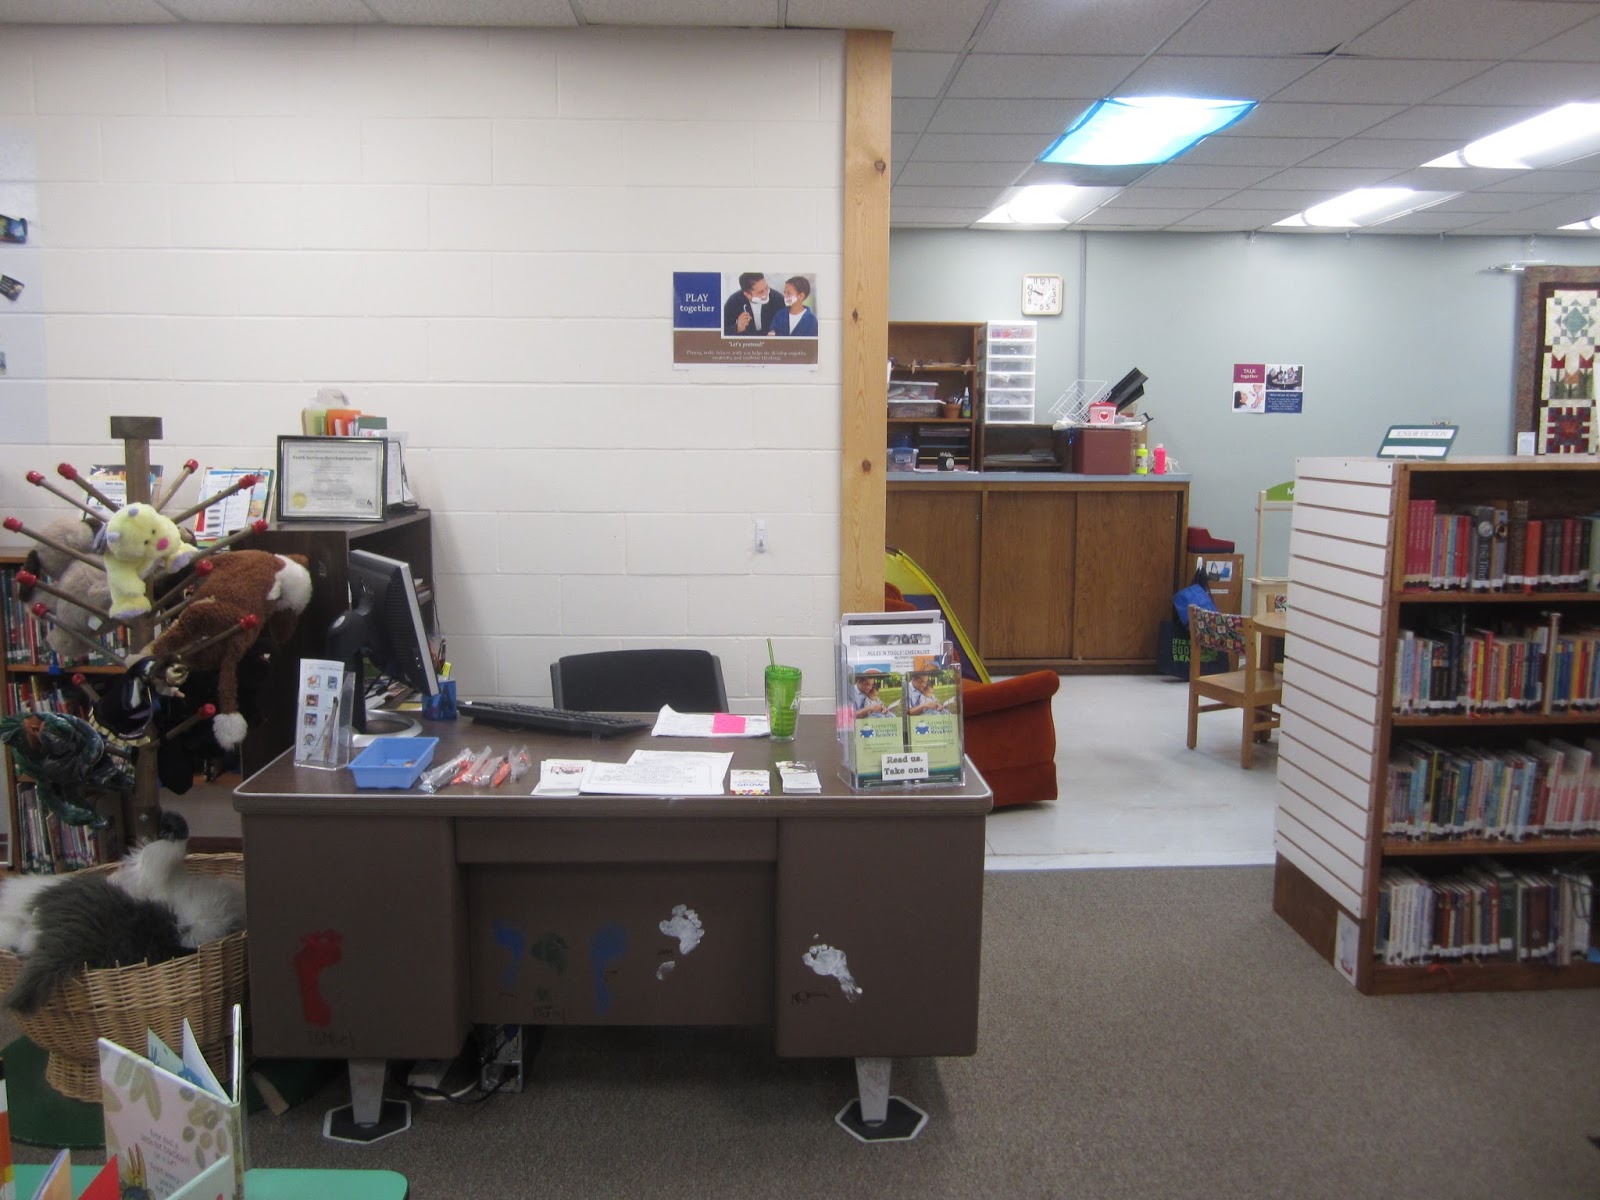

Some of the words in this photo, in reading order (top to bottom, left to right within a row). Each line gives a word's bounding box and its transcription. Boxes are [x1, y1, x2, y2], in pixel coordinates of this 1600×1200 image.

[685, 293, 709, 302] PLAY
[680, 303, 715, 314] together
[887, 756, 908, 764] Read
[884, 767, 905, 775] Take
